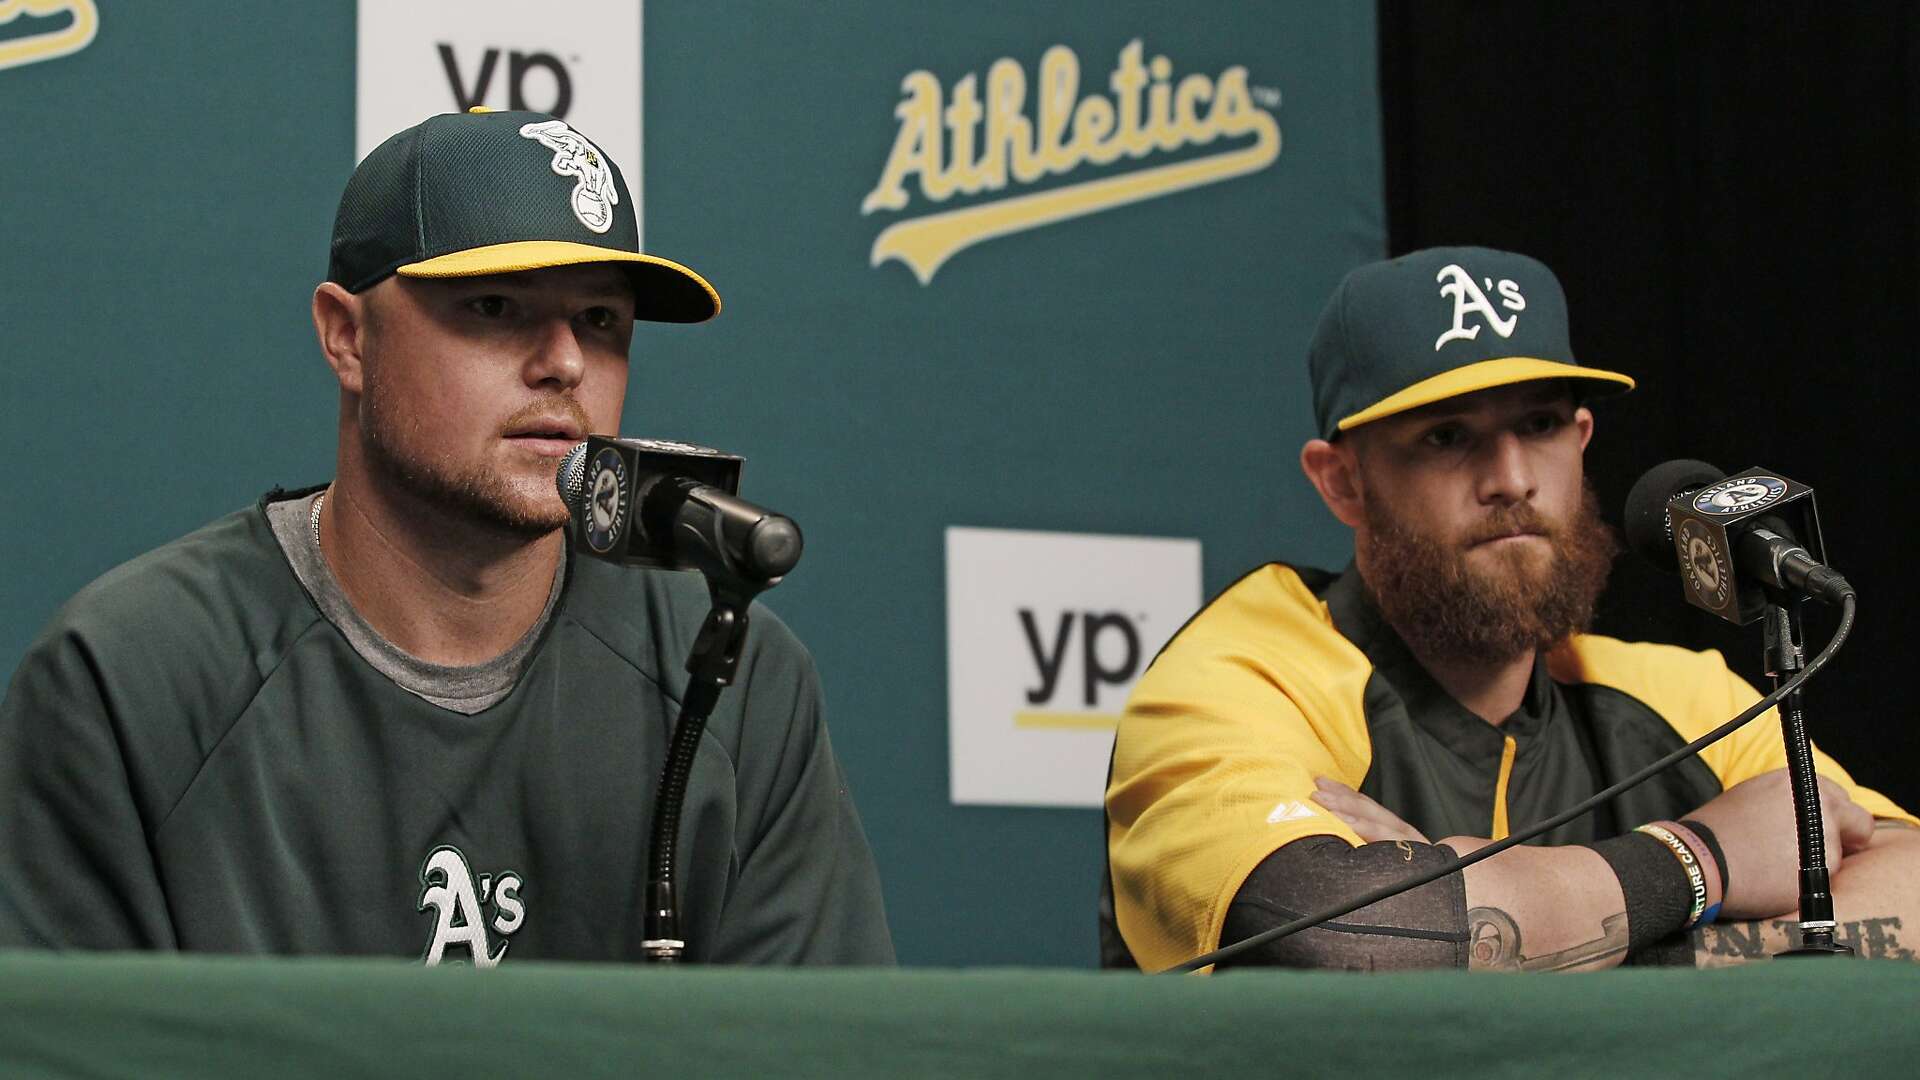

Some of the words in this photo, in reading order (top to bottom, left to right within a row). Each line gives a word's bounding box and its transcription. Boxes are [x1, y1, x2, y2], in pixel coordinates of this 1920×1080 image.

[861, 38, 1252, 216] Athletics
[1435, 264, 1526, 351] A's
[584, 458, 602, 533] OAKLAND
[608, 463, 628, 543] ATHLETICS
[1698, 478, 1757, 503] OAKLAND
[1720, 486, 1783, 513] ATHLETICS
[1680, 527, 1701, 590] OAKLAND
[1018, 608, 1141, 707] yp
[420, 847, 526, 968] A's
